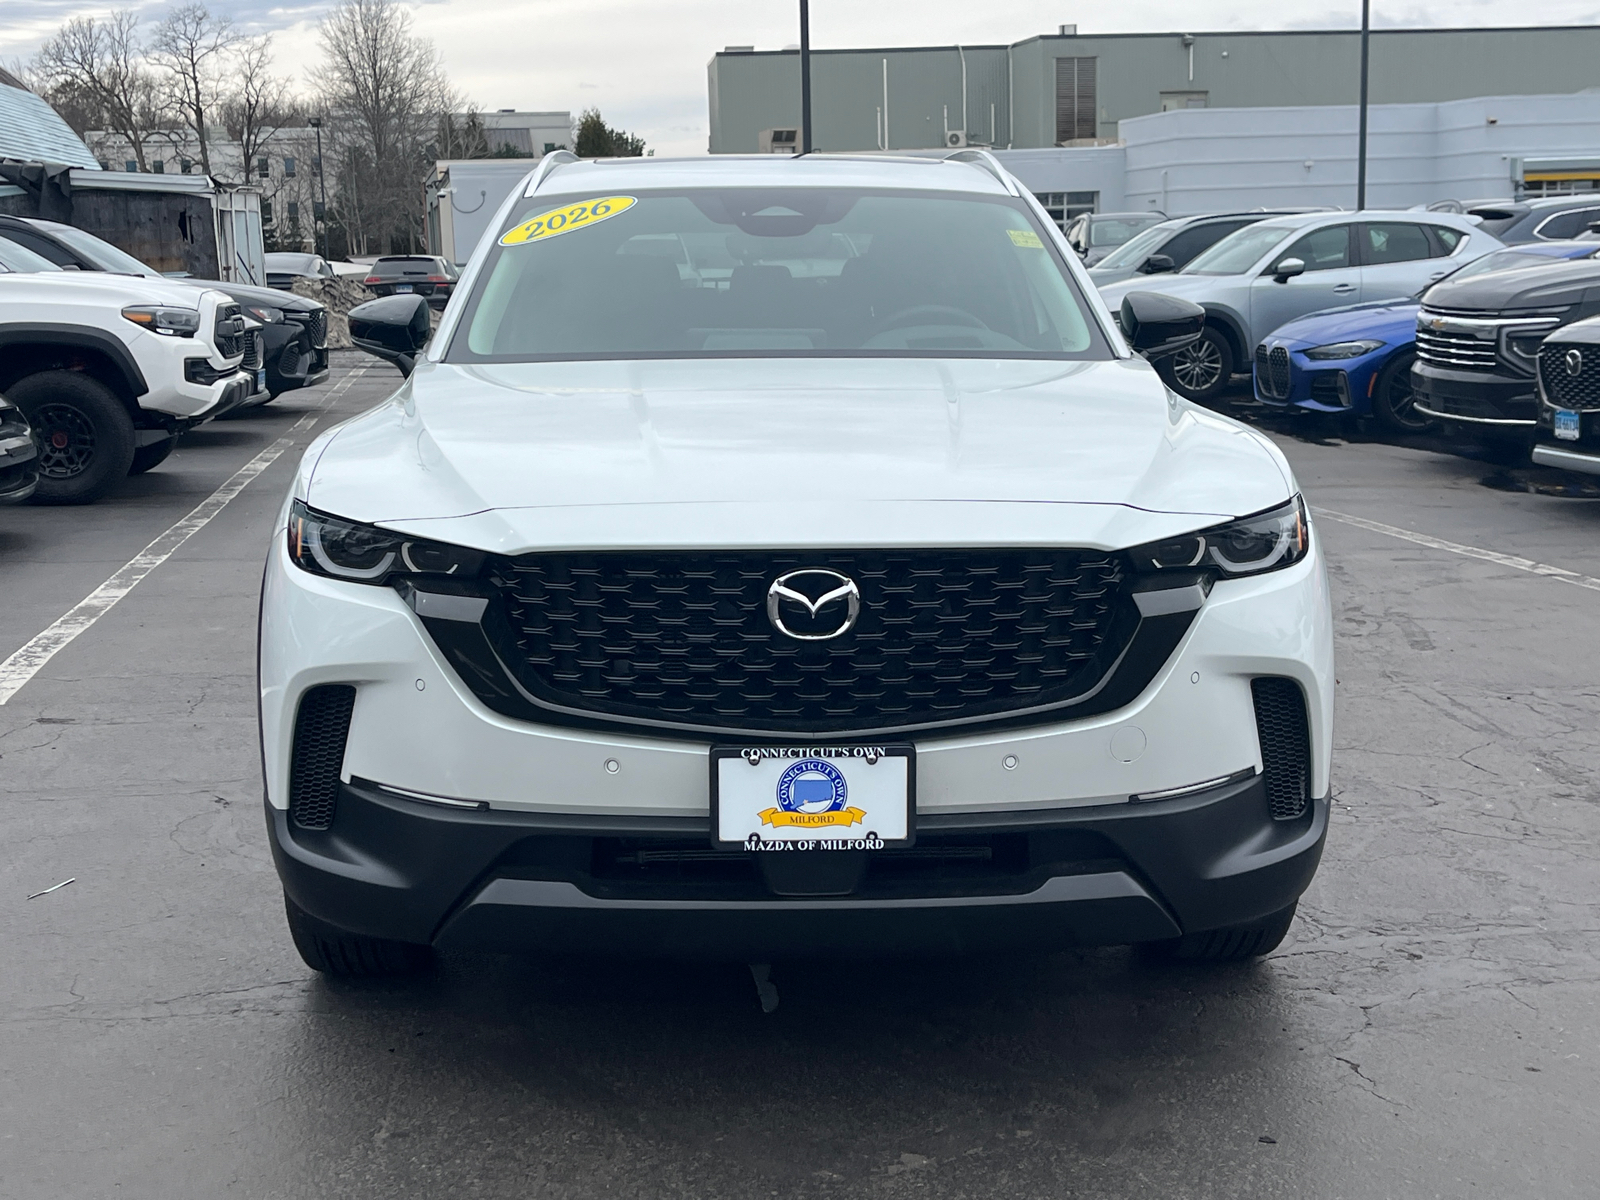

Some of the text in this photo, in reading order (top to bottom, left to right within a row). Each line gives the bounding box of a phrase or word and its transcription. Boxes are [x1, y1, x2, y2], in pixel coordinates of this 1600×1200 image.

[525, 200, 611, 240] 2026
[741, 747, 886, 758] CONNECTICUT'S OWN
[781, 762, 845, 805] CONNECTICUT'S OWN
[789, 815, 835, 824] MILFORD
[743, 839, 884, 851] MAZDA OF MILFORD
